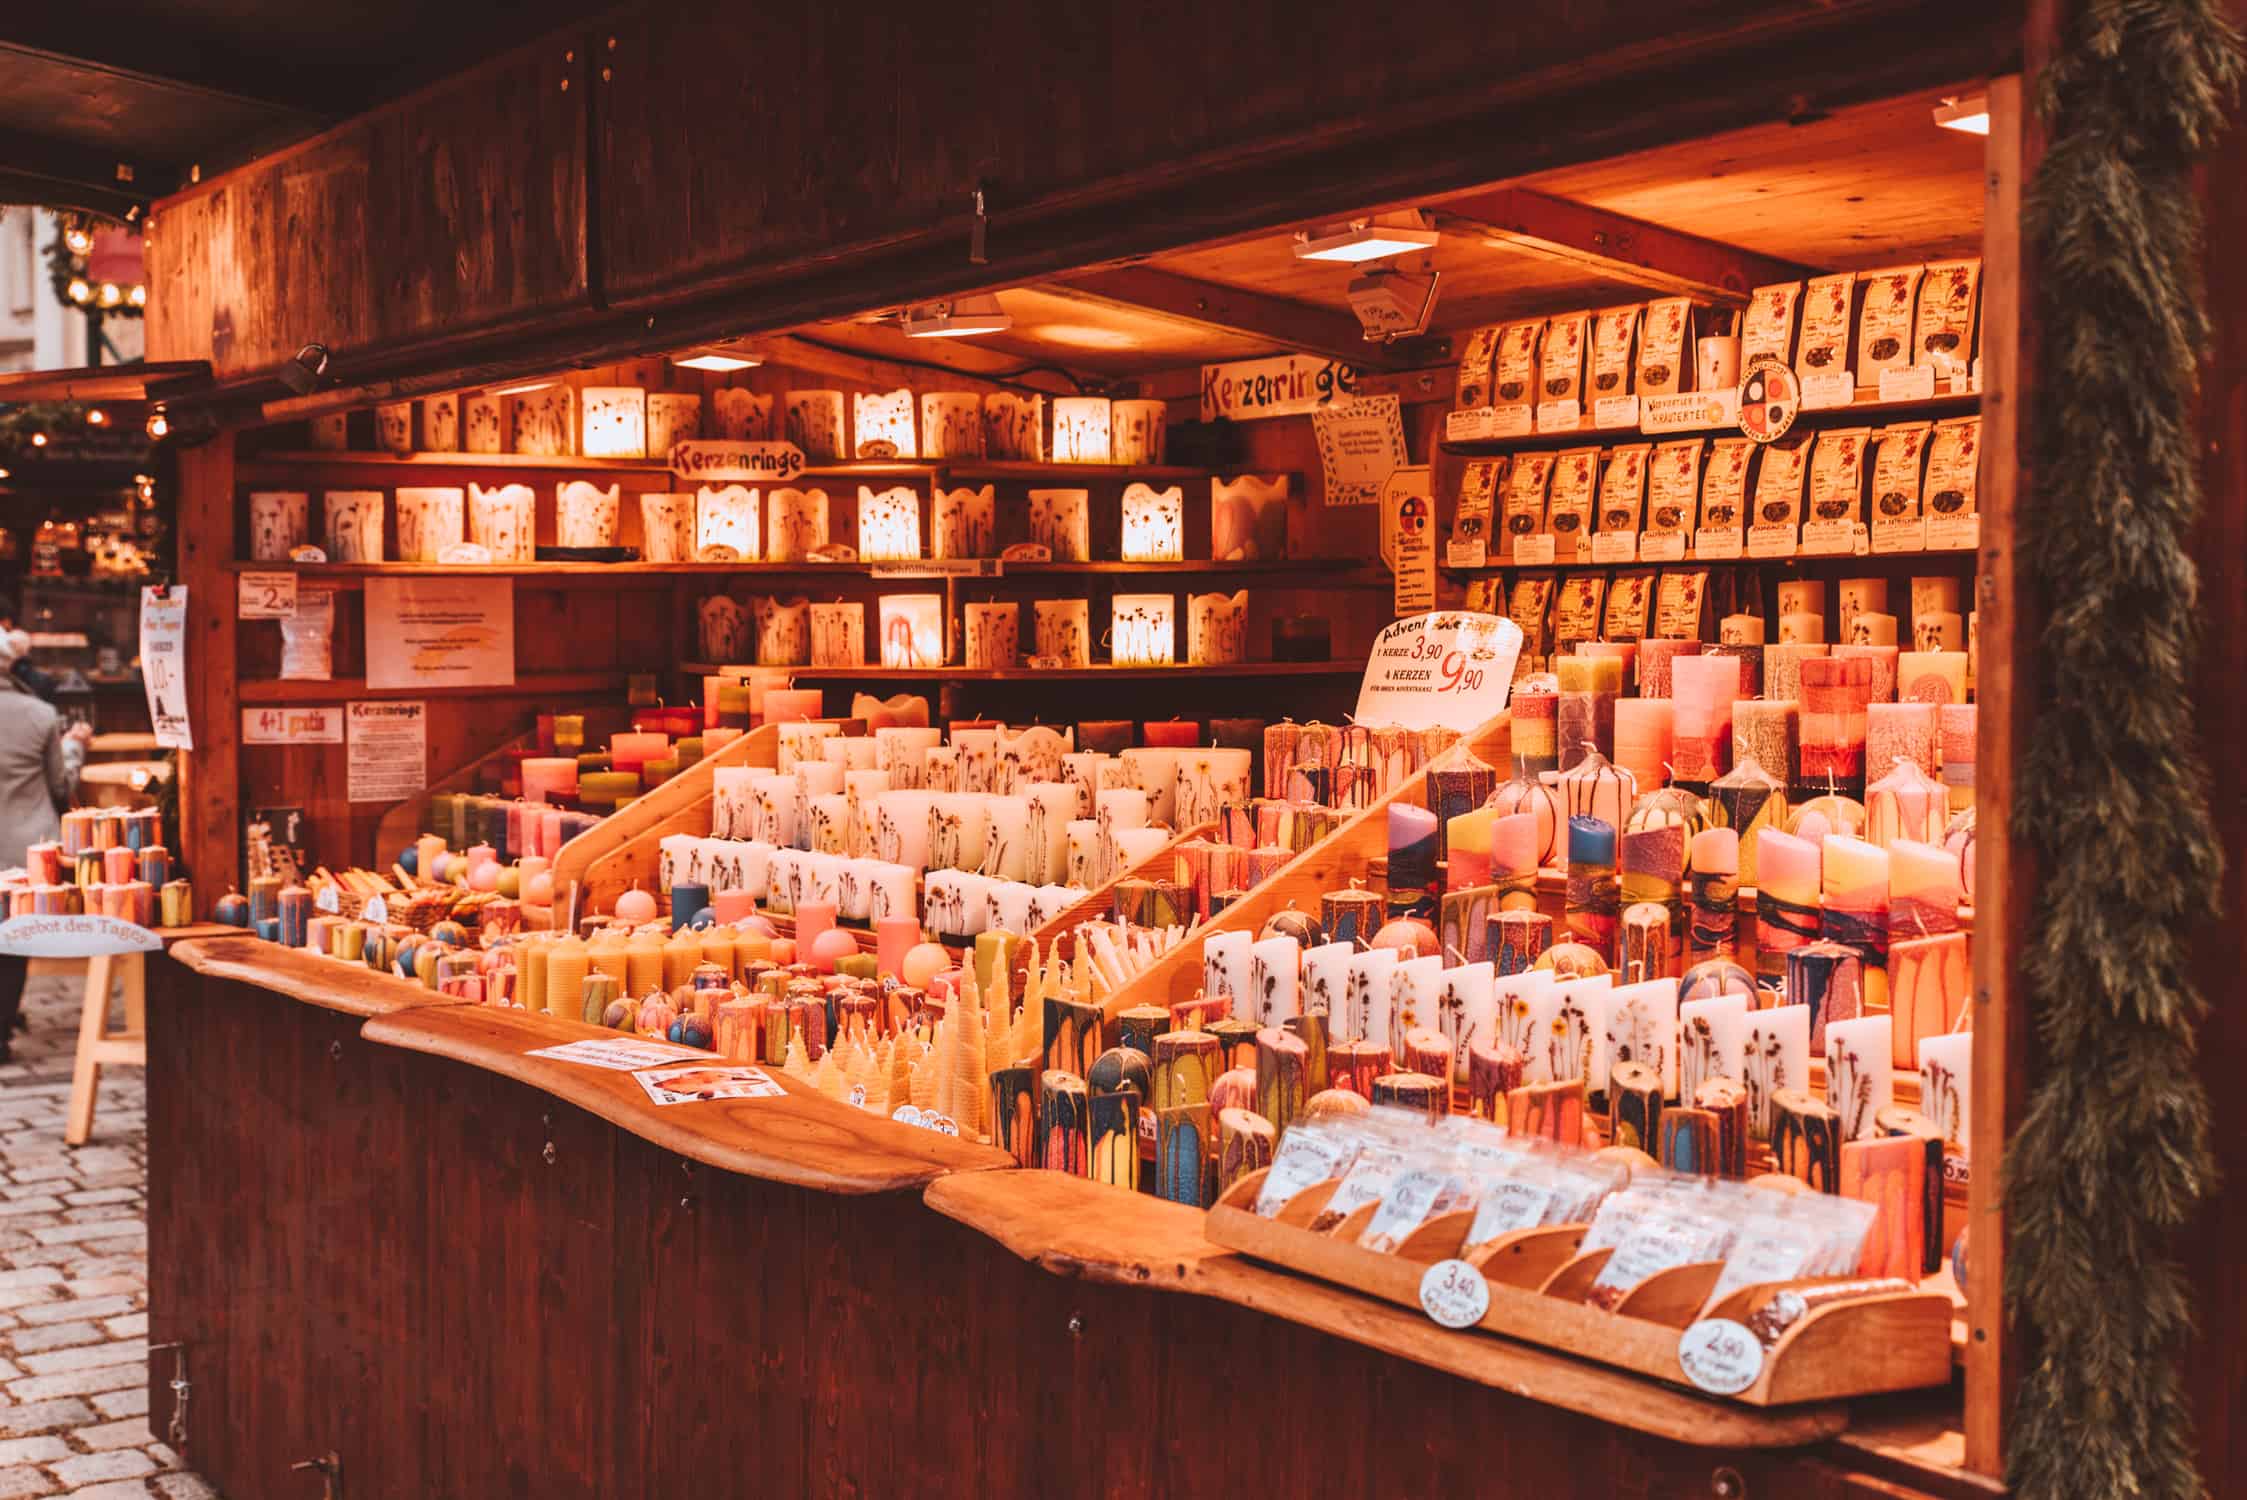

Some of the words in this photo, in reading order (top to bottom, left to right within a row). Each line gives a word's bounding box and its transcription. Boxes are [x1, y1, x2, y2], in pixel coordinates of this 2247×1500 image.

[673, 444, 801, 478] Kerzenringe
[1383, 648, 1410, 657] KERZE
[1411, 635, 1443, 662] 3,90
[1393, 669, 1432, 681] KERZEN
[1437, 651, 1484, 695] 9,90
[1442, 1263, 1475, 1299] 3,40
